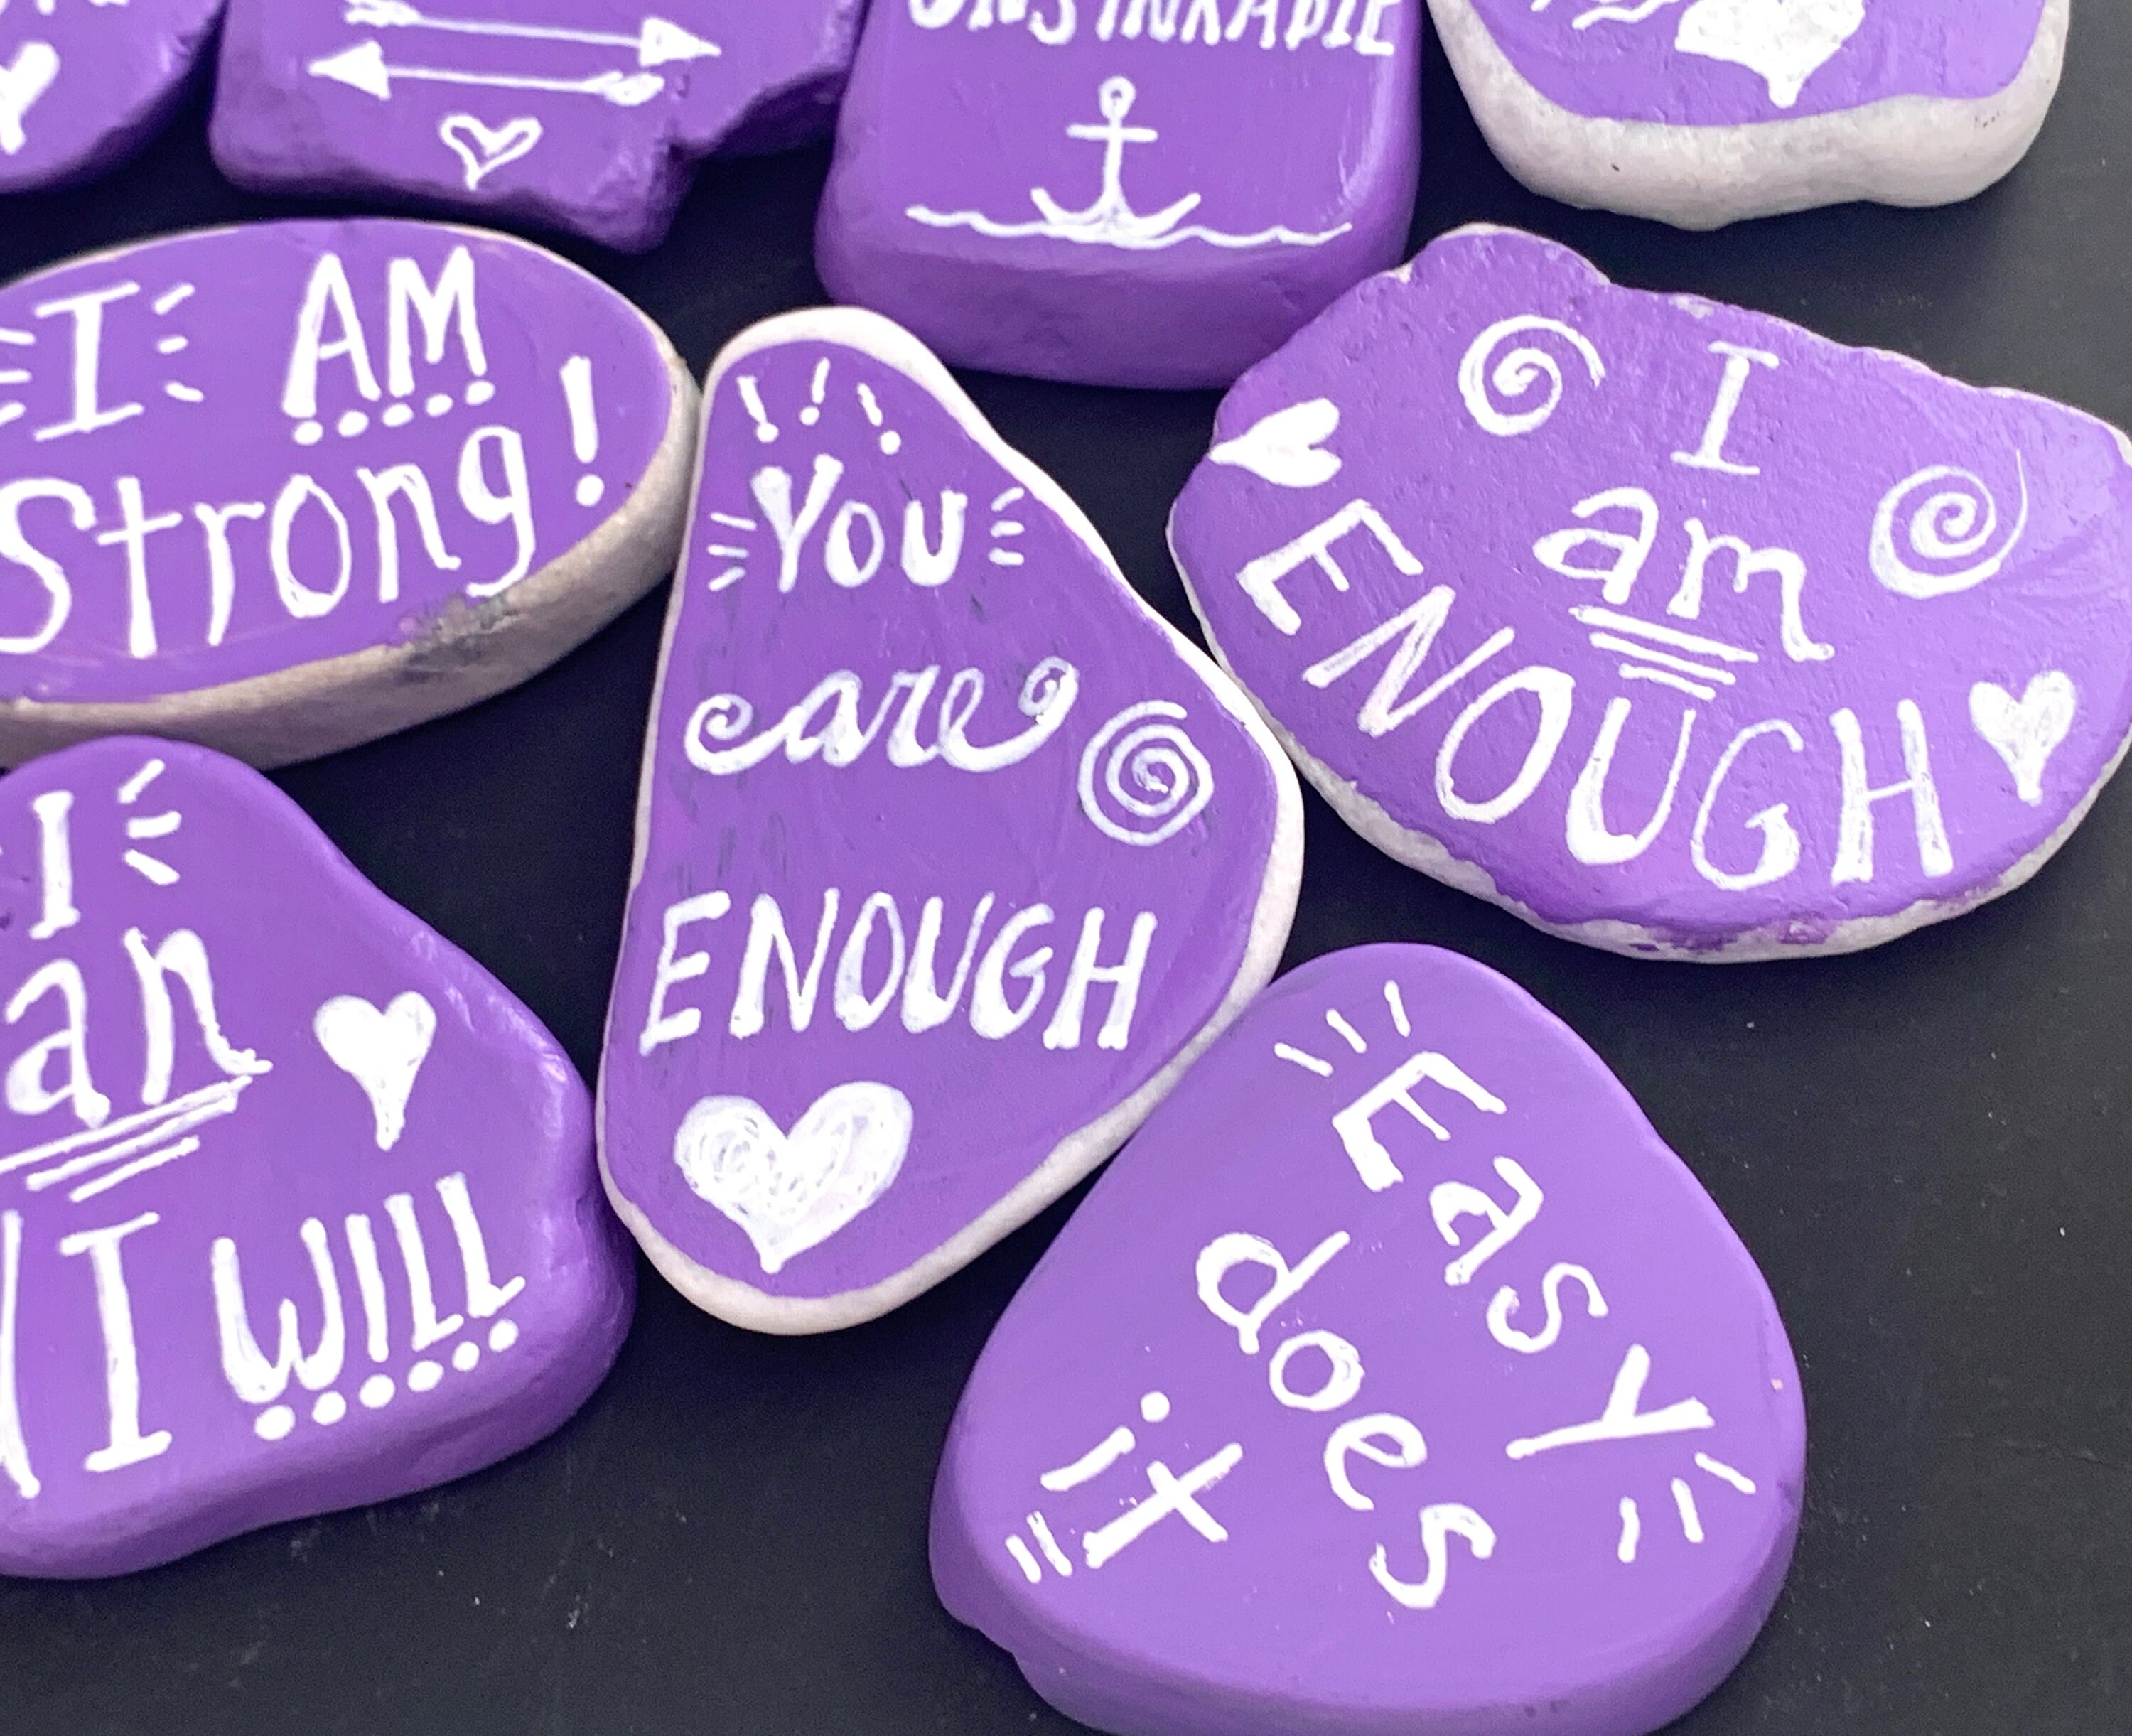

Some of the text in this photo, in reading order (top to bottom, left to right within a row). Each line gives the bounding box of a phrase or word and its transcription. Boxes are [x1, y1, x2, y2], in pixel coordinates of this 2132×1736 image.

[33, 244, 488, 442] I AM
[1670, 340, 1781, 477] I
[1531, 485, 1836, 664] am
[683, 655, 1080, 776] are
[1235, 497, 1956, 893] ENOUGH
[28, 789, 80, 940] I
[638, 887, 1158, 1056] ENOUGH
[59, 1211, 173, 1474] I
[1194, 1229, 1497, 1610] does
[1039, 1391, 1244, 1570] it
